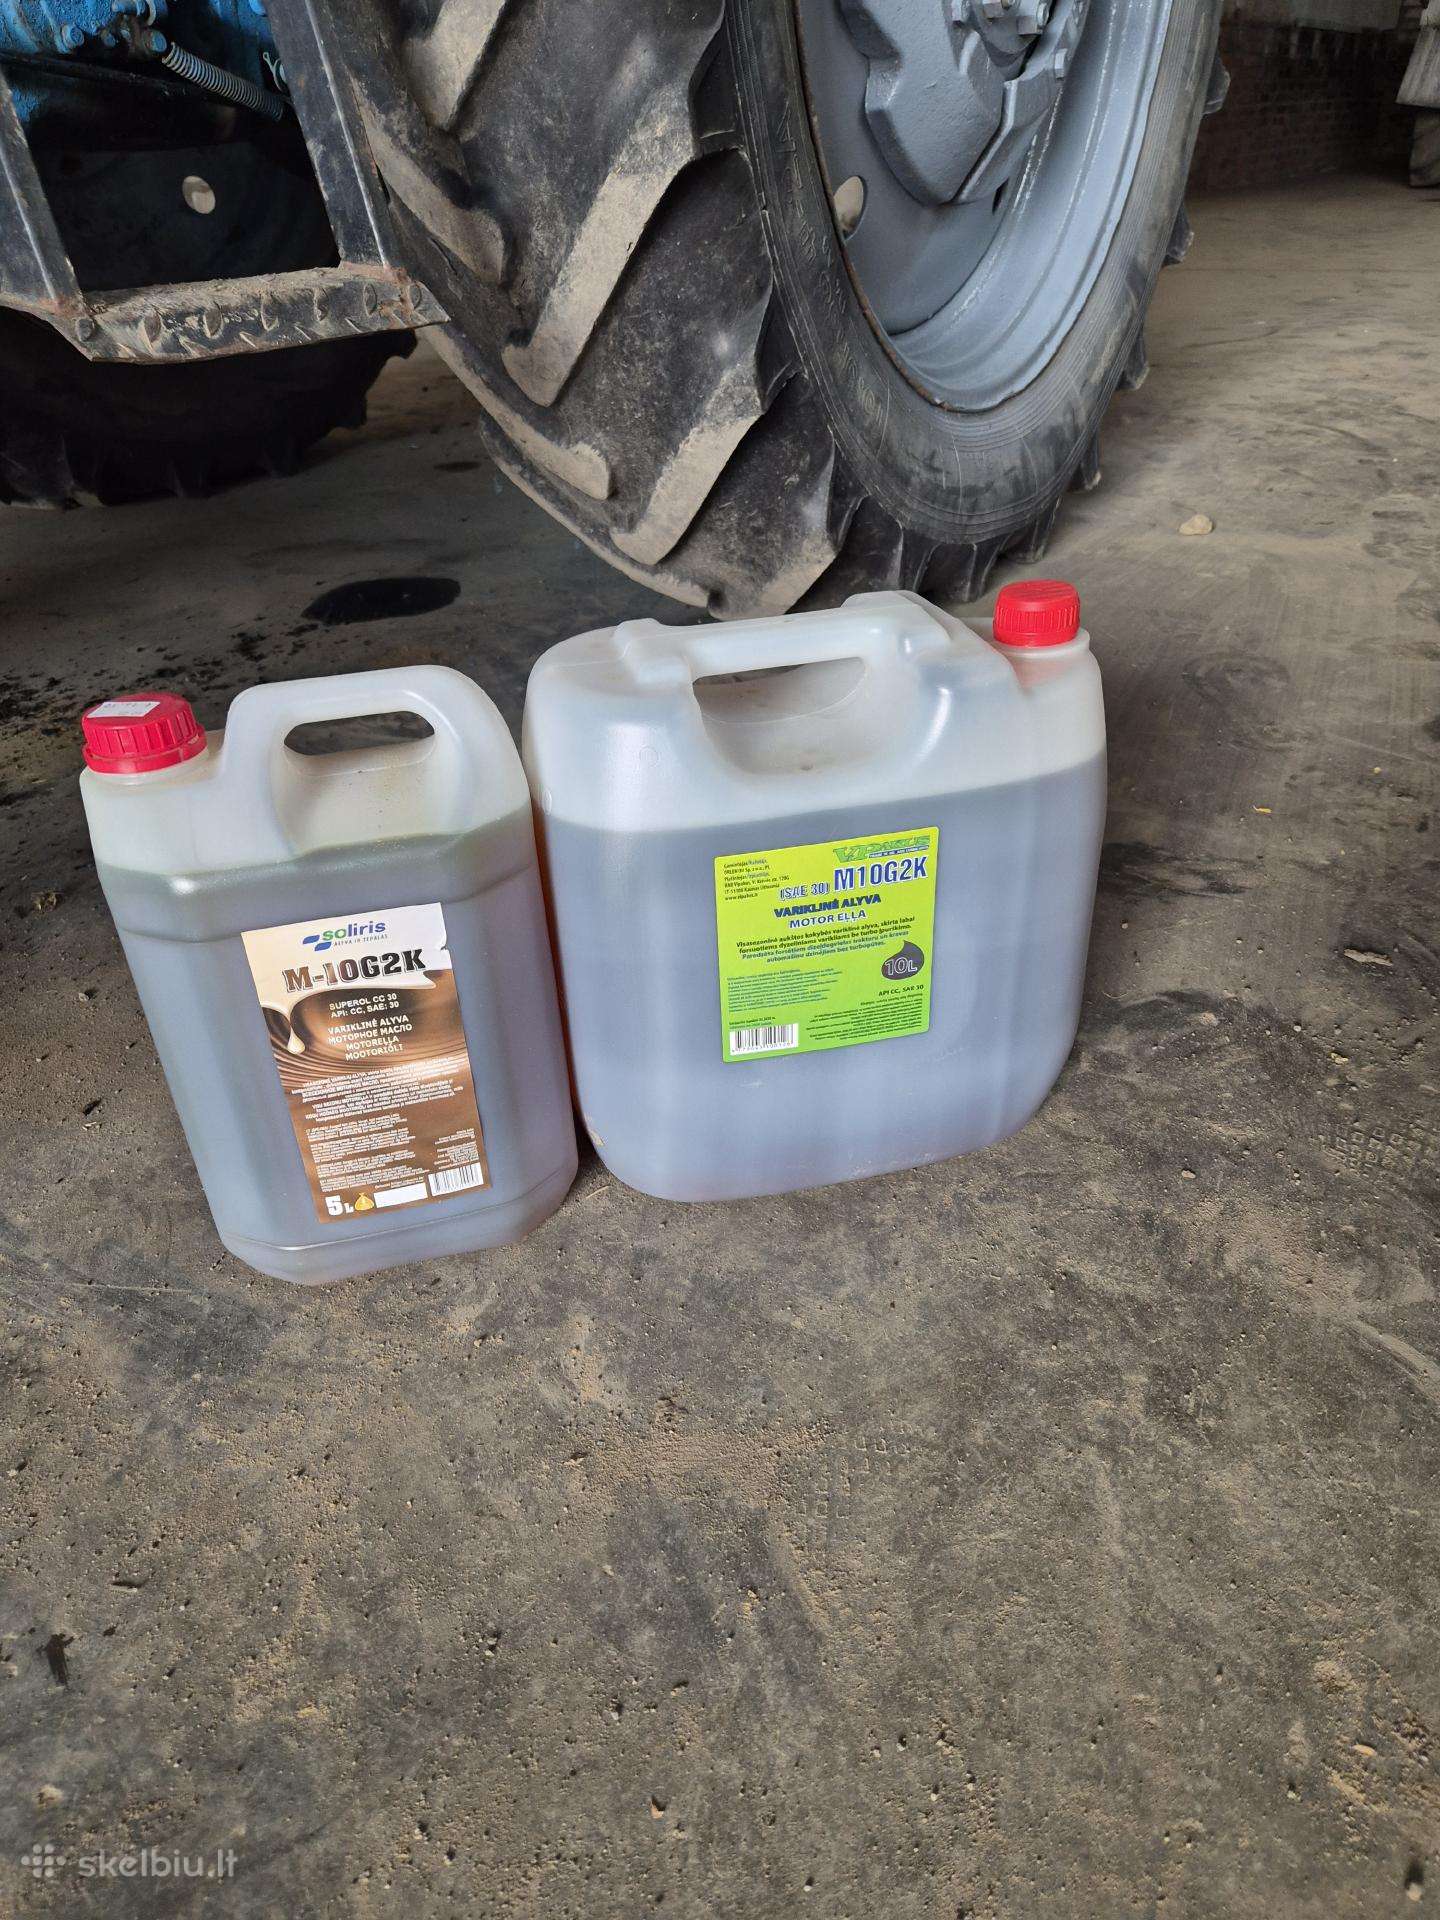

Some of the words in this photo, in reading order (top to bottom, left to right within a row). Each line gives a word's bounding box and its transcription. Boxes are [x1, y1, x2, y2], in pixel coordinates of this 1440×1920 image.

[834, 856, 928, 890] M10G2K
[774, 899, 839, 918] VARIKLINĖ
[841, 893, 882, 909] ALYVA
[789, 915, 835, 929] MOTOR
[837, 910, 866, 923] EĻĻA
[322, 920, 386, 941] soliris
[282, 948, 427, 993] M-10G2K
[885, 957, 918, 976] 10L
[329, 998, 371, 1011] SUPEROL
[372, 994, 386, 1003] CC
[387, 992, 398, 1001] 30
[331, 1009, 349, 1018] API:
[350, 1006, 366, 1015] CC,
[367, 1002, 388, 1013] SAE:
[389, 1000, 400, 1009] 30
[328, 1018, 378, 1035] VARIKLINĖ
[380, 1014, 409, 1027] ALYVA
[328, 1028, 378, 1045] МОТОРНОЕ
[380, 1023, 413, 1036] МАСЛО
